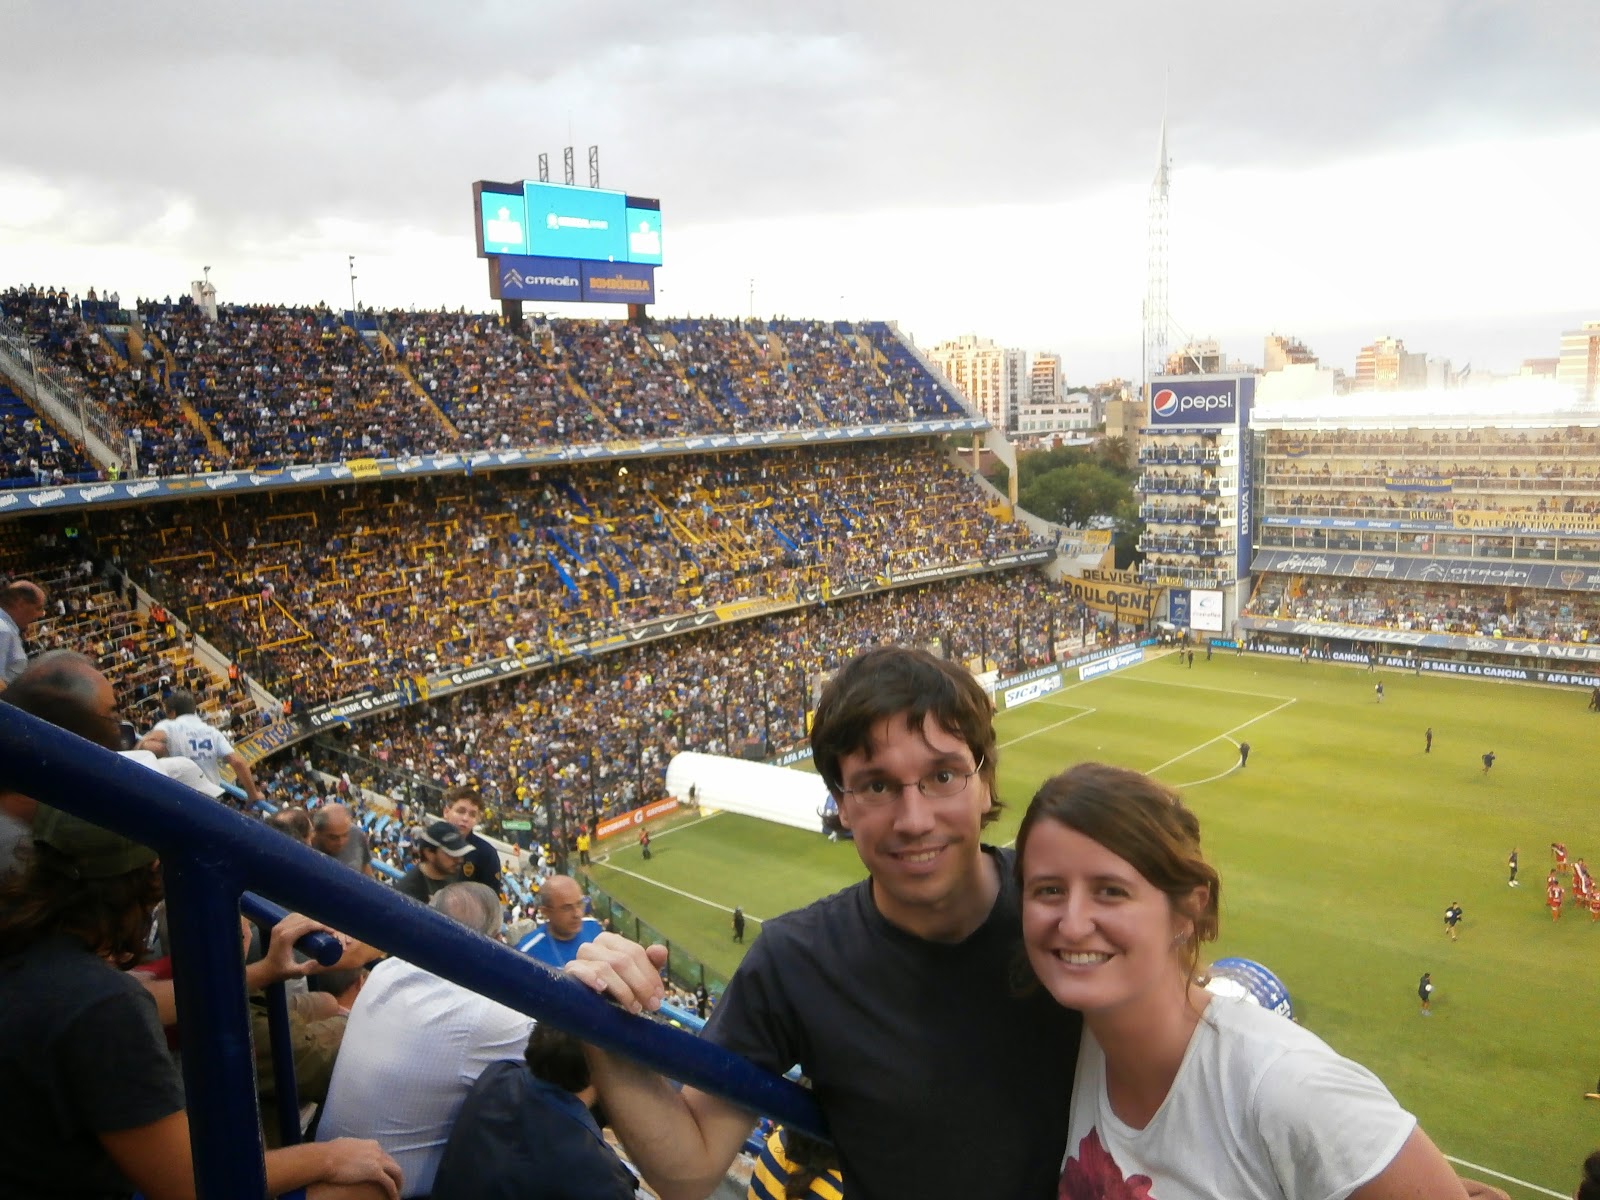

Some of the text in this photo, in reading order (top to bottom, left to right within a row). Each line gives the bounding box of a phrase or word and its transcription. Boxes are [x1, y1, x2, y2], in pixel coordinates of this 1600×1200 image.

[1181, 391, 1231, 412] pepsi
[1241, 490, 1250, 535] BBVA
[1064, 579, 1155, 612] BOULOGNE
[1265, 643, 1288, 655] PLUS
[1312, 649, 1318, 658] A
[1332, 651, 1370, 664] CANCHA
[1386, 657, 1404, 667] AFA
[1432, 661, 1457, 673] SALE
[1458, 664, 1466, 673] A
[1468, 664, 1481, 675] LA
[1484, 667, 1527, 680] CANCHA
[1547, 673, 1600, 687] AFA PLUS
[188, 738, 213, 752] 14
